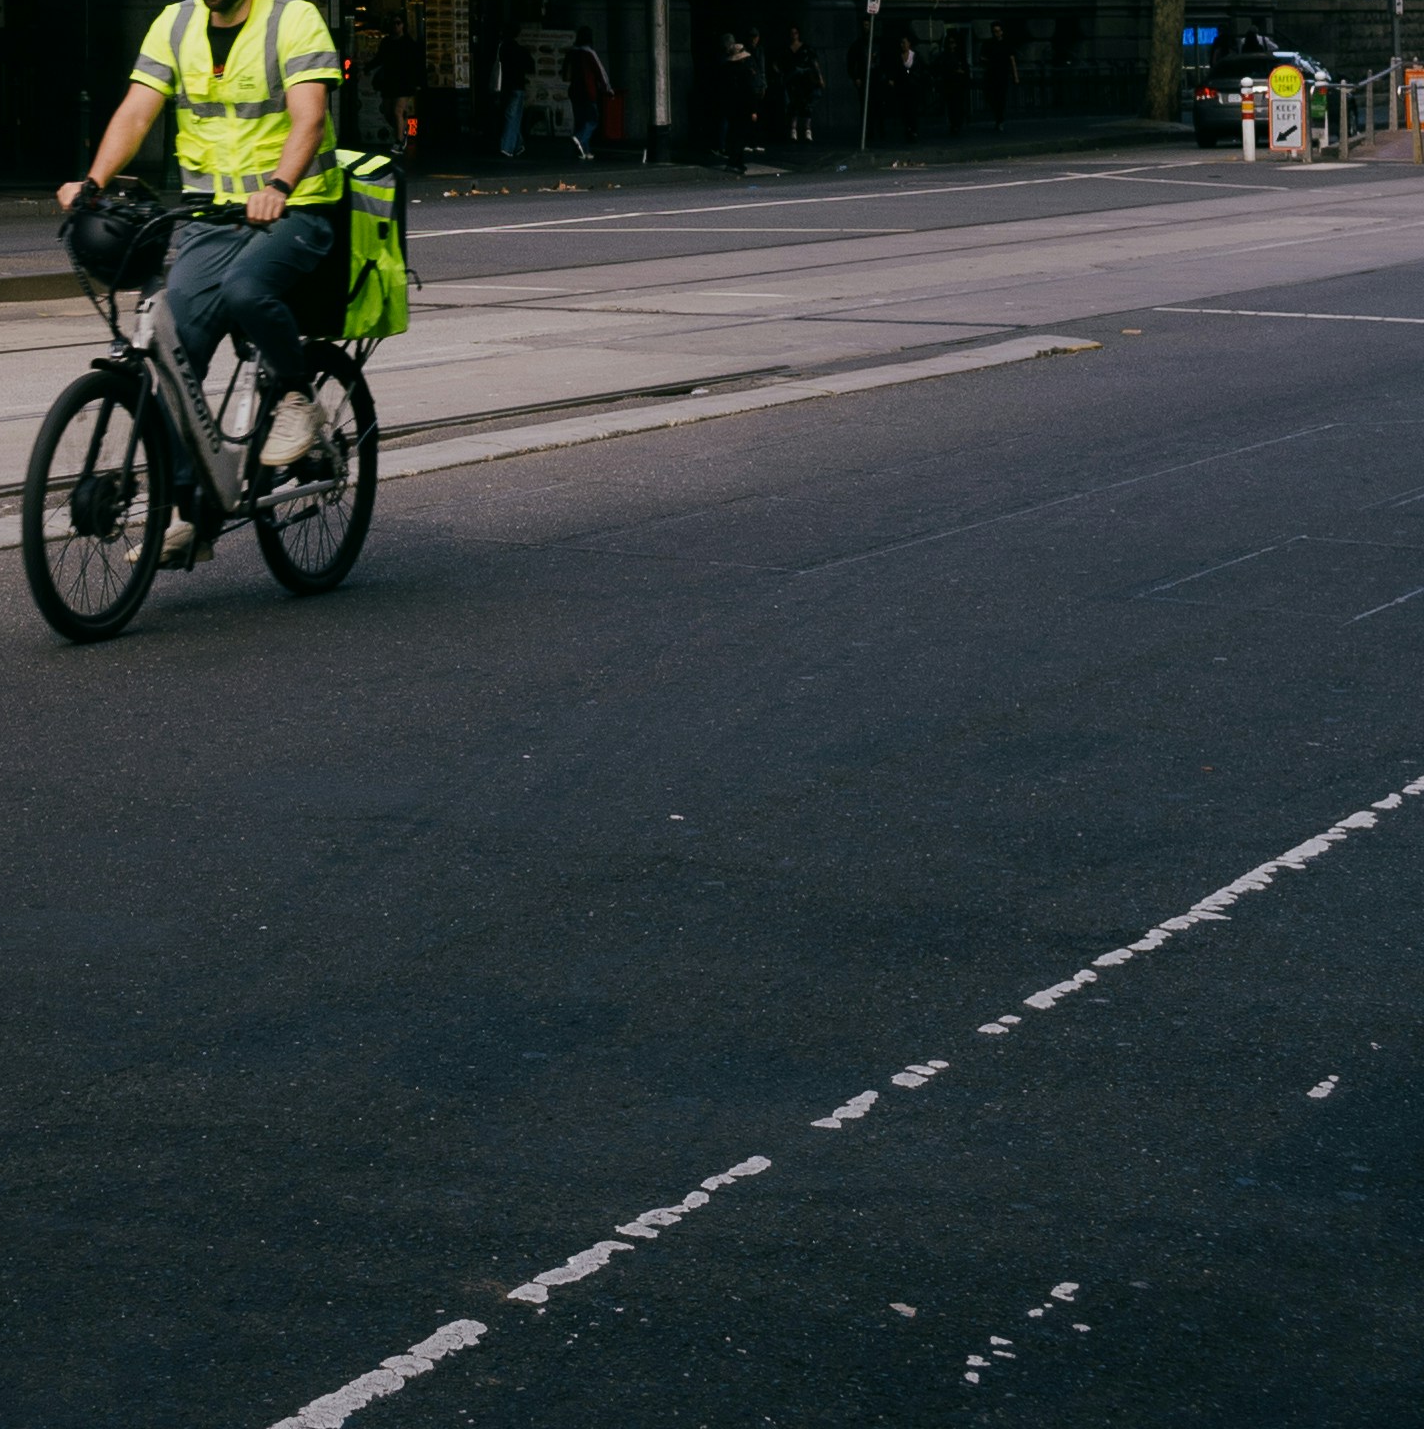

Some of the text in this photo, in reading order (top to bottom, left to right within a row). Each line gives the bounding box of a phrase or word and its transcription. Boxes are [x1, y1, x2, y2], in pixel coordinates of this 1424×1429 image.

[1274, 75, 1298, 83] SAFETY
[1277, 84, 1294, 93] ZONE
[1276, 104, 1297, 112] KEEP
[1276, 113, 1296, 121] LEFT
